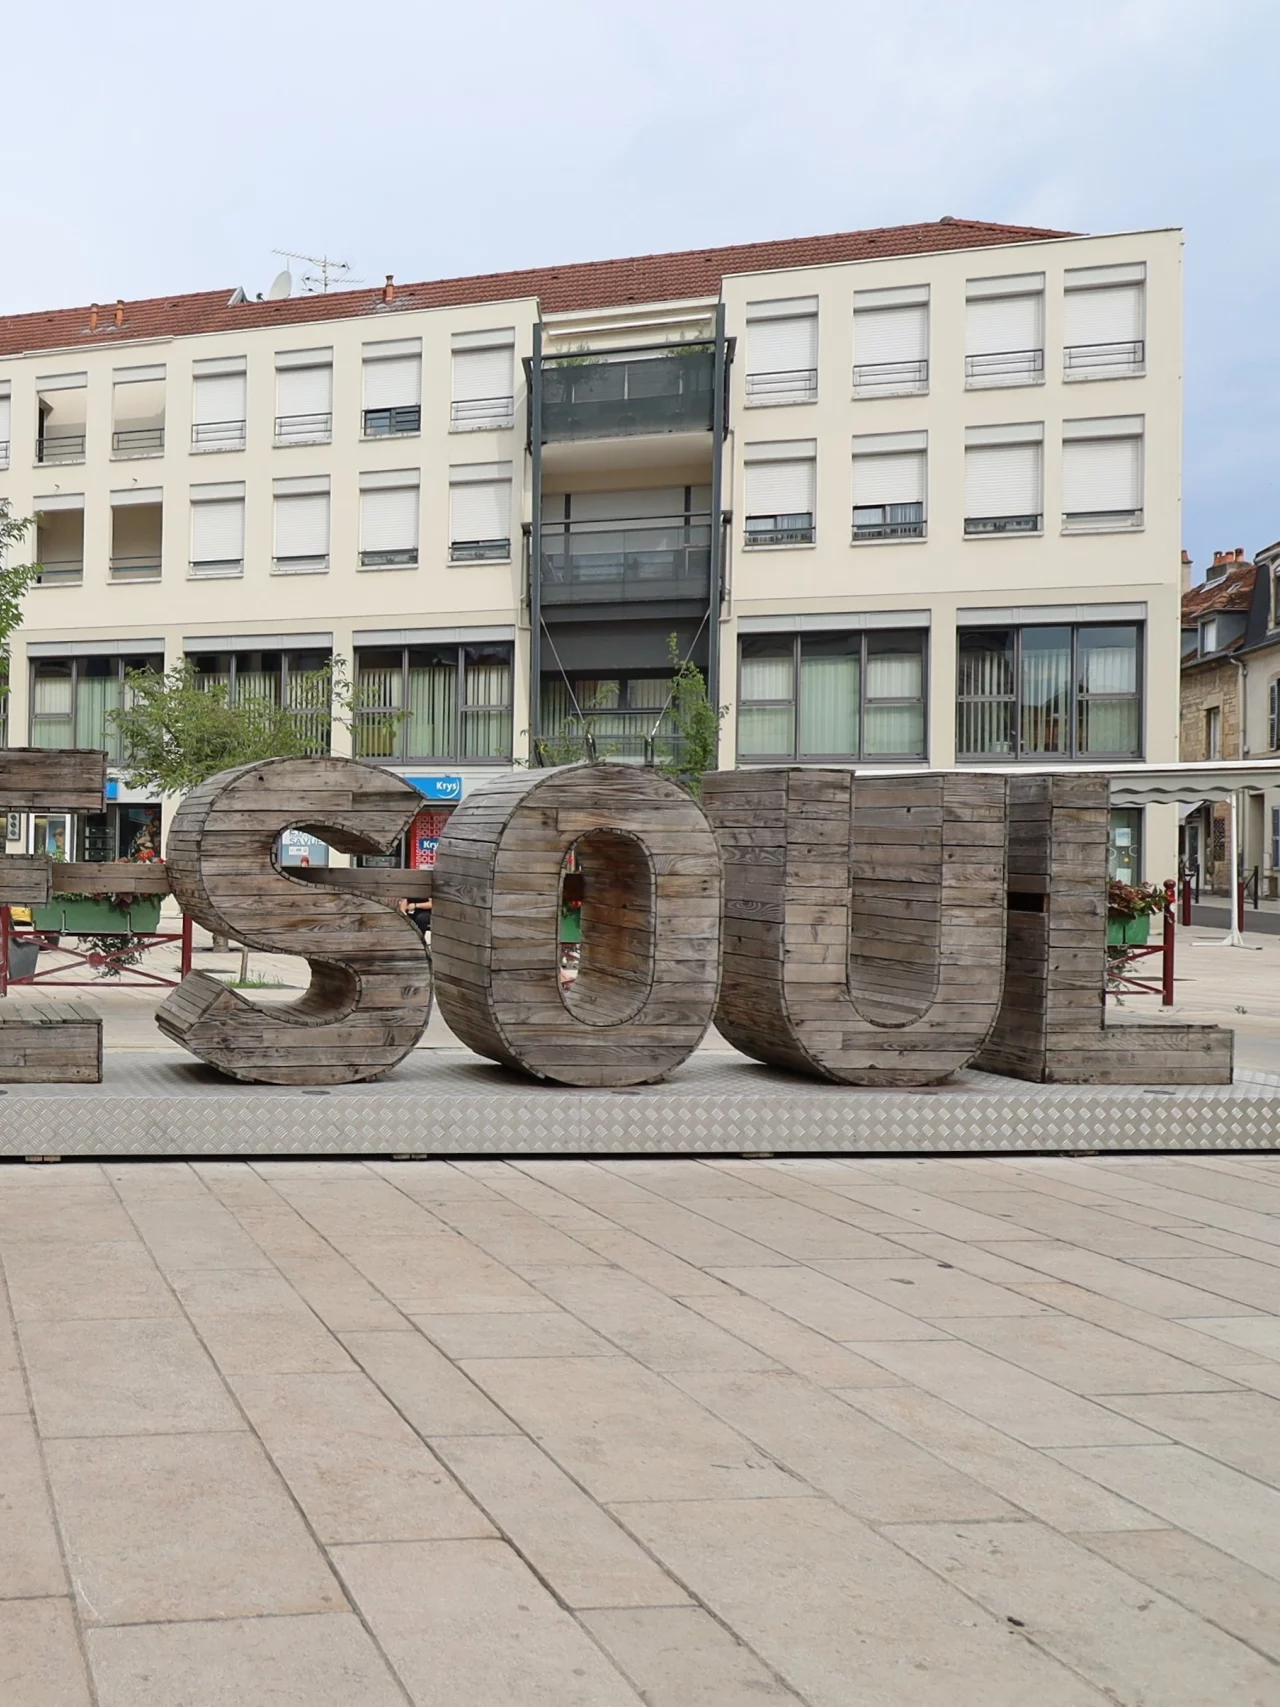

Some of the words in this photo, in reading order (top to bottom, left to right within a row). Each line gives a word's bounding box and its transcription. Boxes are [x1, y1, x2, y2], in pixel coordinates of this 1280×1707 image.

[436, 781, 457, 793] Krys
[416, 815, 449, 823] SOLDE
[423, 840, 439, 851] Kry
